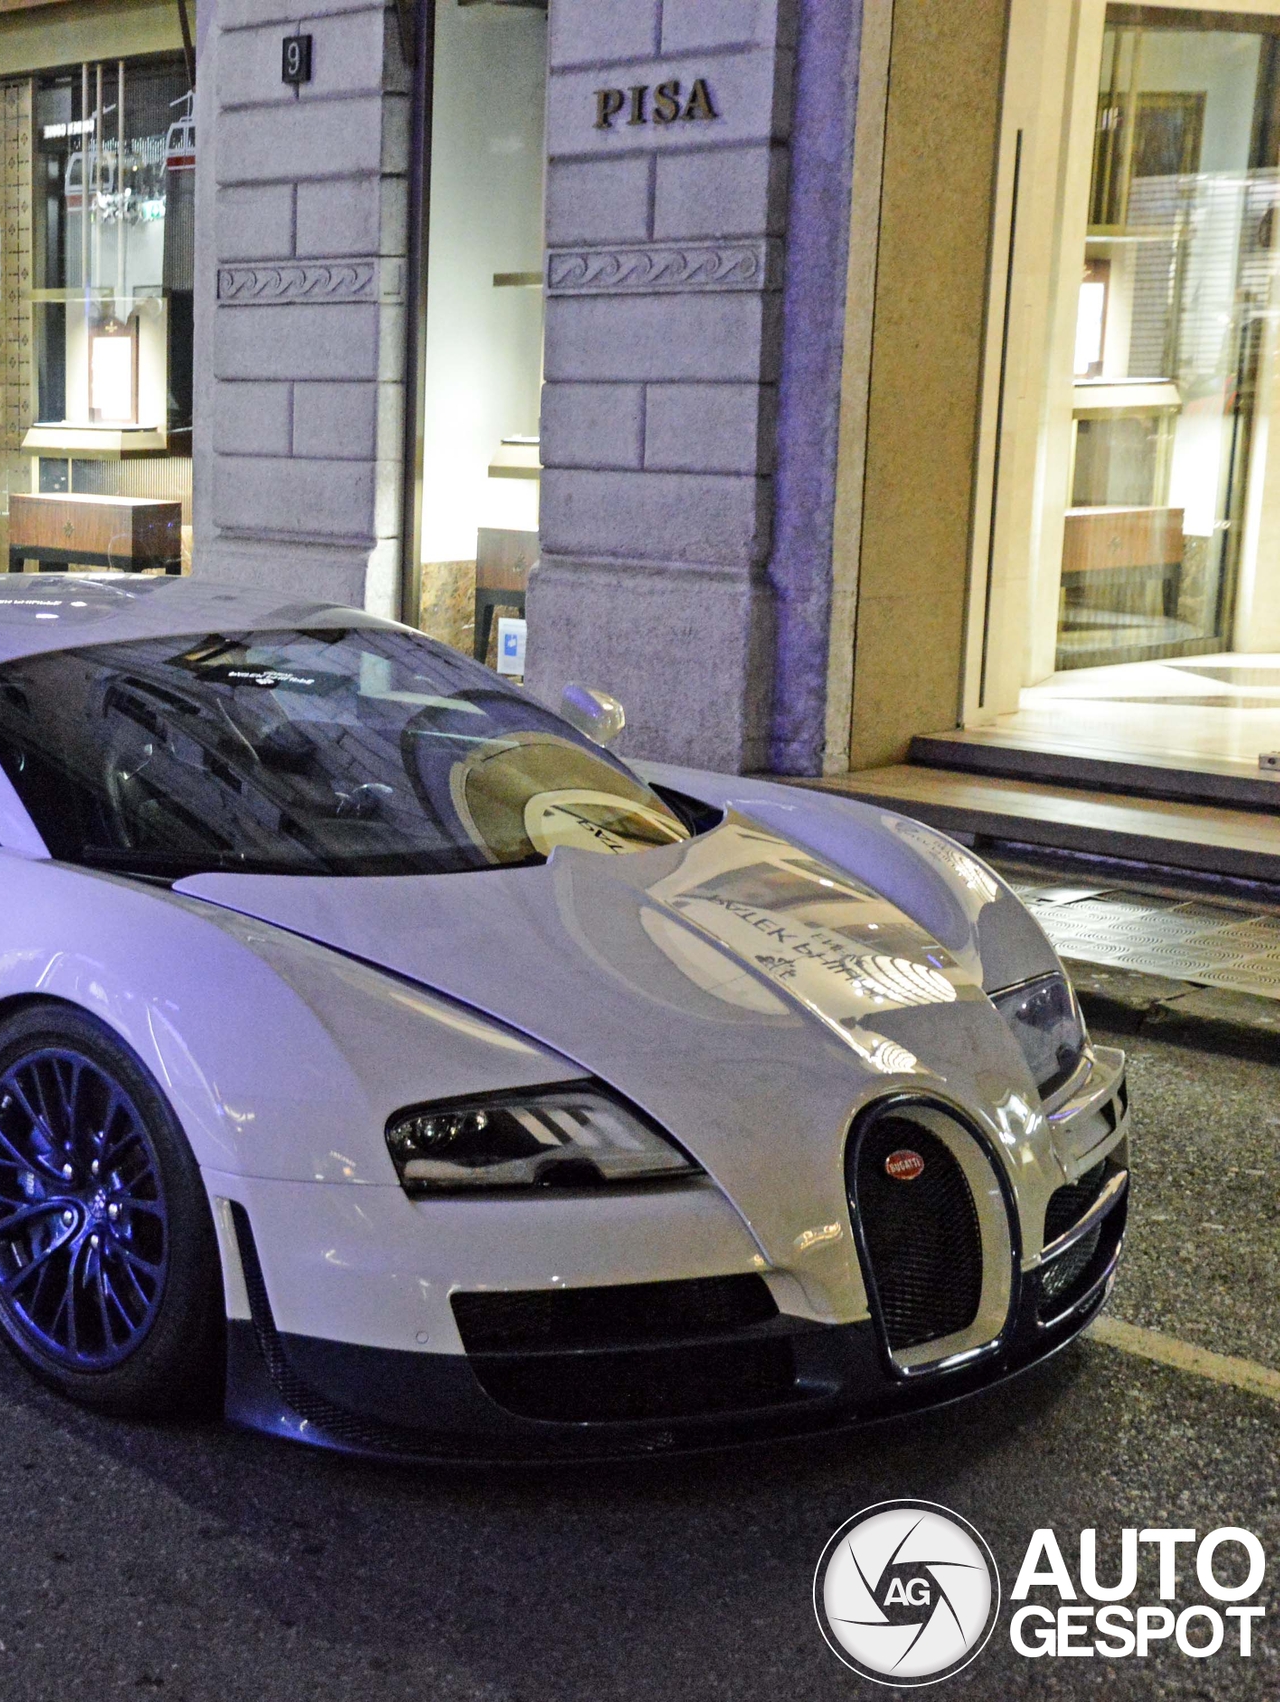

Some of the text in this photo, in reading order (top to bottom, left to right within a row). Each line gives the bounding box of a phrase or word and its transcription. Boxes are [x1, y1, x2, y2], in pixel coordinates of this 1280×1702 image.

[287, 41, 300, 75] 9
[592, 79, 719, 129] PISA
[889, 1157, 922, 1173] BUGATTI
